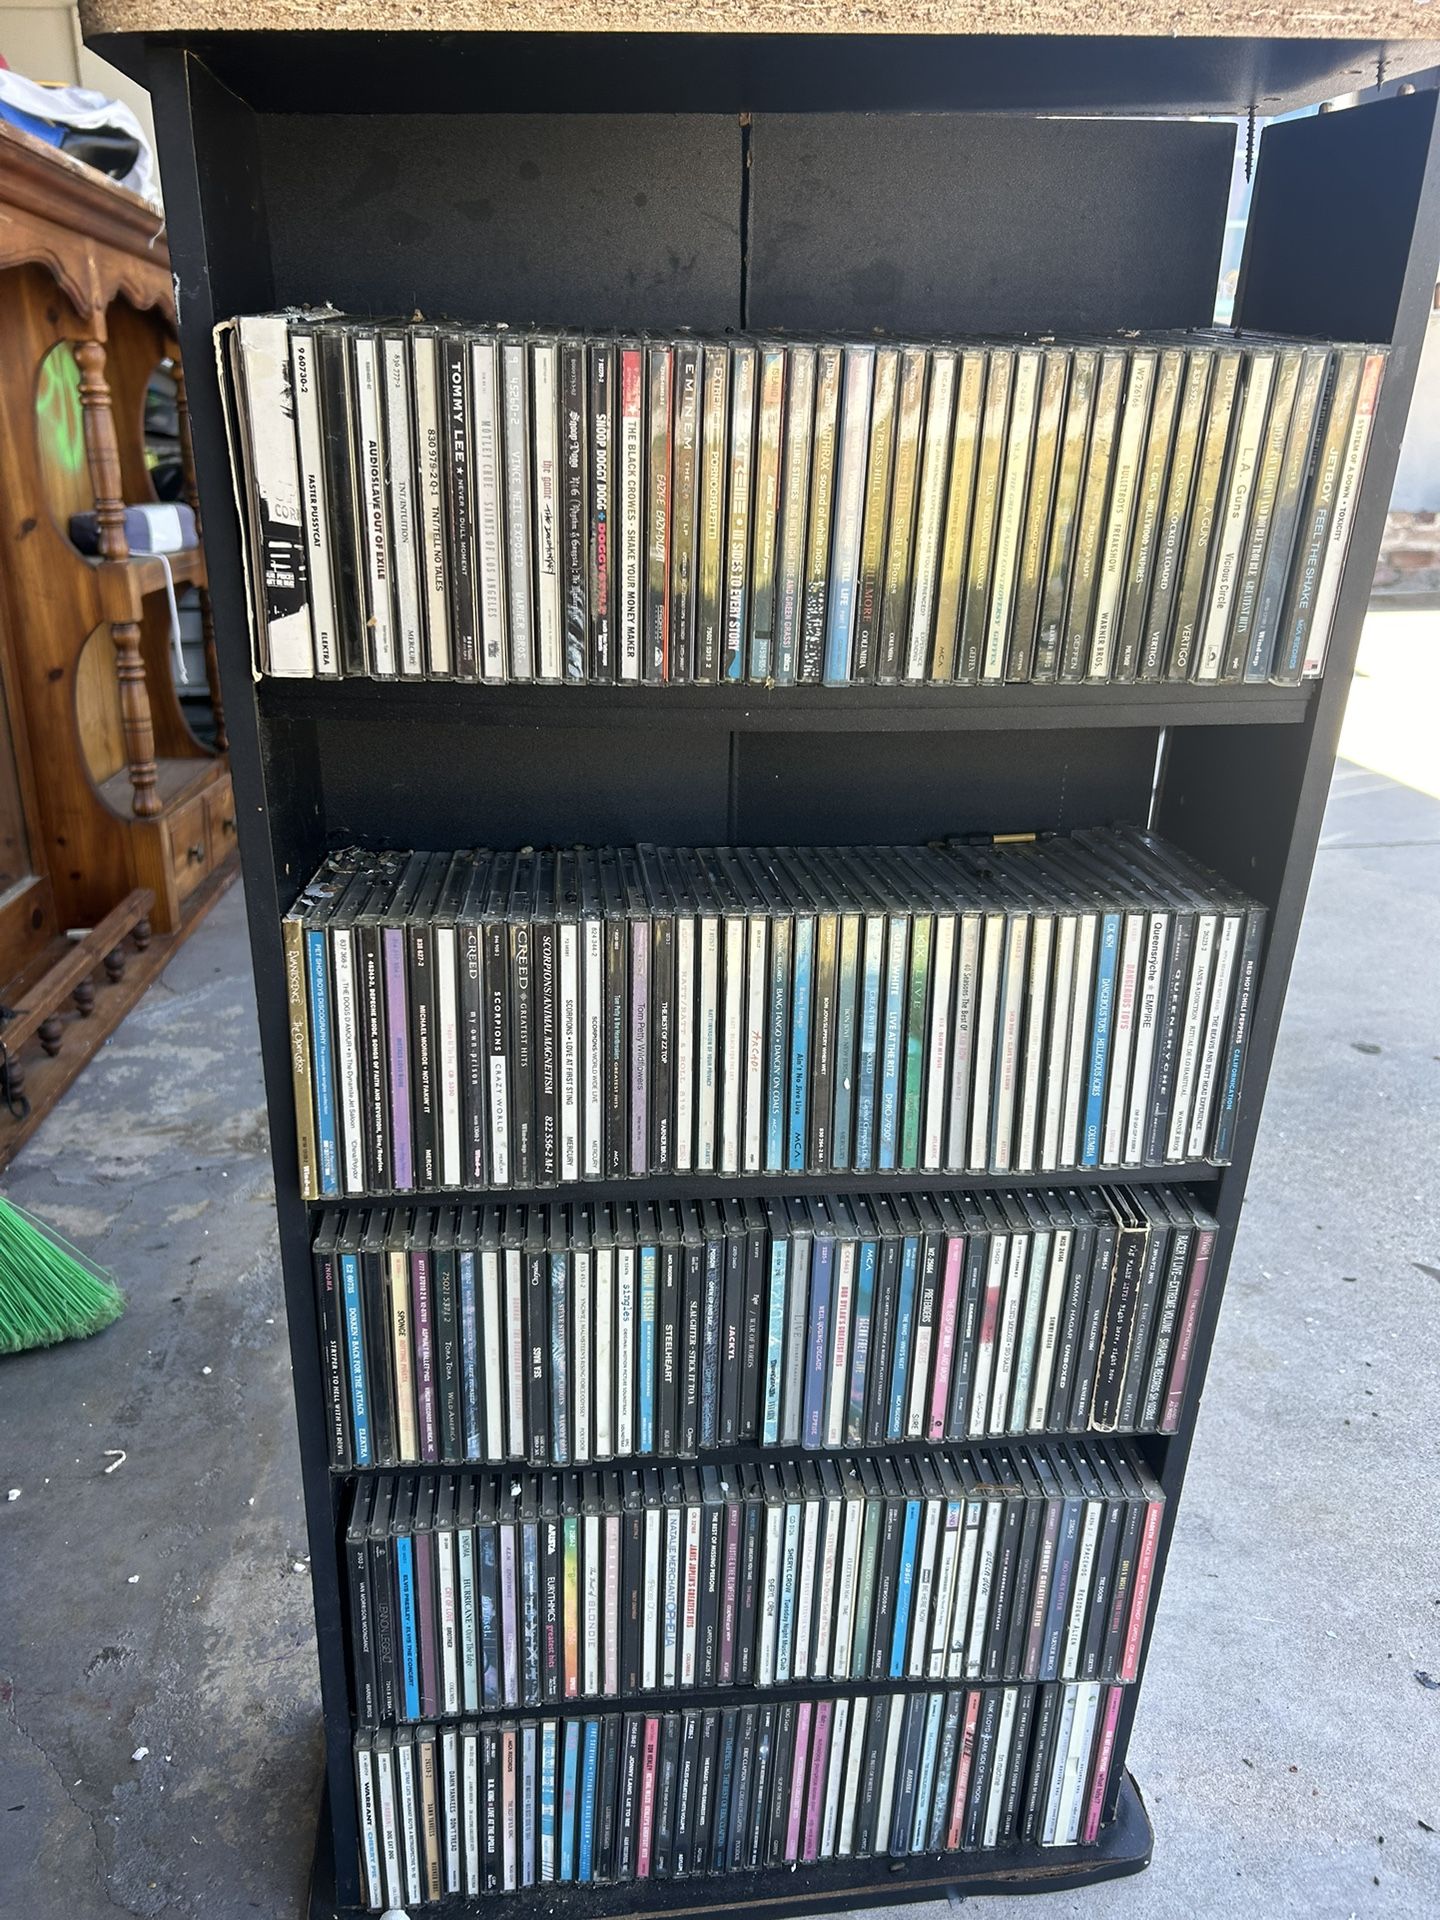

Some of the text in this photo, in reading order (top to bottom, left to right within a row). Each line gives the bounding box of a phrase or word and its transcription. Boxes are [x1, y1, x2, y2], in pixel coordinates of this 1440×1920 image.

[453, 362, 463, 425] TOMMY
[684, 364, 693, 449] EMINEM
[455, 430, 464, 462] LEE
[1351, 419, 1366, 450] SYSTEM
[542, 460, 553, 499] the game
[595, 414, 607, 510] SNOOP DOGGY DOGG
[1349, 454, 1358, 463] OF
[814, 420, 832, 574] ANTHRAX sound of white noise
[1342, 474, 1354, 498] DOWN
[368, 440, 385, 579] AUDIOSLAVE OUT OF EXILE
[428, 429, 443, 591] 830 979-2 Q-1 TNT/TELL NO TALES
[1216, 448, 1254, 608] L.A. Guns Vicious Circle
[1299, 447, 1339, 608] JETBOY FEEL THE SHAKE
[1333, 508, 1347, 541] TOXICITY
[512, 452, 526, 663] VINCE NEIL EXPOSED WARNER BROS.
[627, 422, 636, 657] THE BLACK CROWES SHAKE YOUR MONEY MAKER
[308, 475, 330, 665] FASTER PUSSYCAT ELEKTRA
[399, 482, 416, 665] TNT/INTUITION MERCURY
[1094, 465, 1131, 669] BULLETBOYS FREAKSHOW WARNER BROS.
[1177, 624, 1192, 666] VERTIGO
[518, 931, 528, 989] CREED
[543, 936, 552, 1094] SCORPIONS/ANIMAL MAGNETISM
[775, 988, 783, 1009] BANG
[1143, 994, 1153, 1028] EMPIRE
[318, 998, 326, 1044] DISCOGRAPHY
[420, 1005, 428, 1036] MICHAEL
[774, 1011, 782, 1036] TANGO
[1226, 961, 1253, 1110] RED HOT CHILI PEPPERS CALIFORNICATION
[636, 1004, 645, 1090] Tom Petty Wildflowers
[495, 1064, 503, 1094] CRAZY
[773, 1077, 781, 1089] ON
[772, 1090, 781, 1113] COALS
[397, 1311, 406, 1336] SPONGE
[623, 1284, 632, 1321] singles
[922, 1289, 933, 1322] PRETENDERS
[688, 1301, 697, 1404] SLAUGHTER STICK IT TO YA
[728, 1325, 736, 1360] JACKYL
[1060, 1274, 1080, 1388] SAMMY HAGAR UNBOXED
[333, 1376, 339, 1384] TO
[350, 1308, 368, 1457] DOKKEN BACK FOR THE ATTACK ELEKTRA
[463, 1579, 472, 1623] HURRICANE
[547, 1577, 555, 1667] EURYTHMICS greatest hits
[780, 1549, 794, 1670] SHERYL CROW Tuesday Night Music Club
[984, 1714, 993, 1732] FLOYD
[987, 1700, 995, 1713] PINK
[976, 1775, 984, 1784] THE
[979, 1753, 987, 1764] SIDE
[364, 1782, 373, 1825] WARRANT
[974, 1786, 982, 1803] MOON
